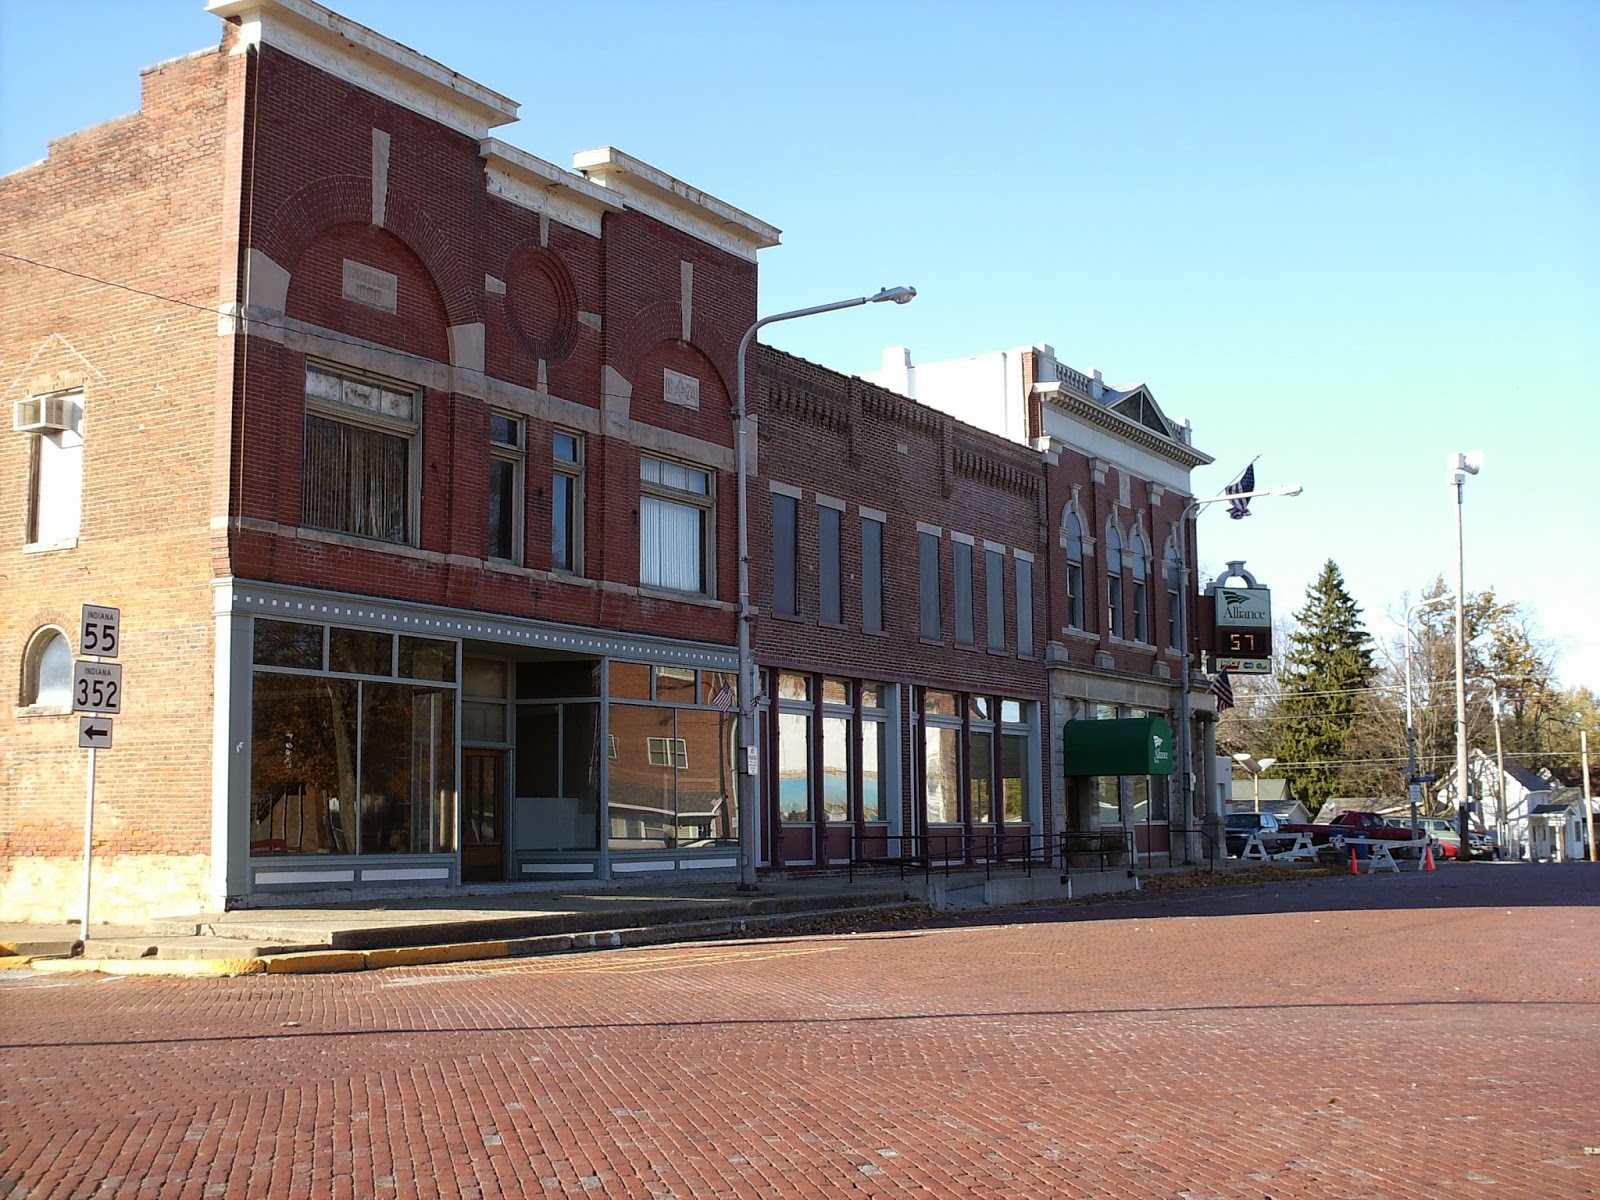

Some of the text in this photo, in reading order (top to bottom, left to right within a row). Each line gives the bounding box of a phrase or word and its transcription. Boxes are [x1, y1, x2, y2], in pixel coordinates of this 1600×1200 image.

[87, 611, 114, 621] INDIANA
[1223, 606, 1266, 620] Alliance
[84, 623, 116, 652] 55
[1230, 634, 1254, 650] 57
[85, 667, 112, 677] INDIANA
[77, 679, 118, 708] 352
